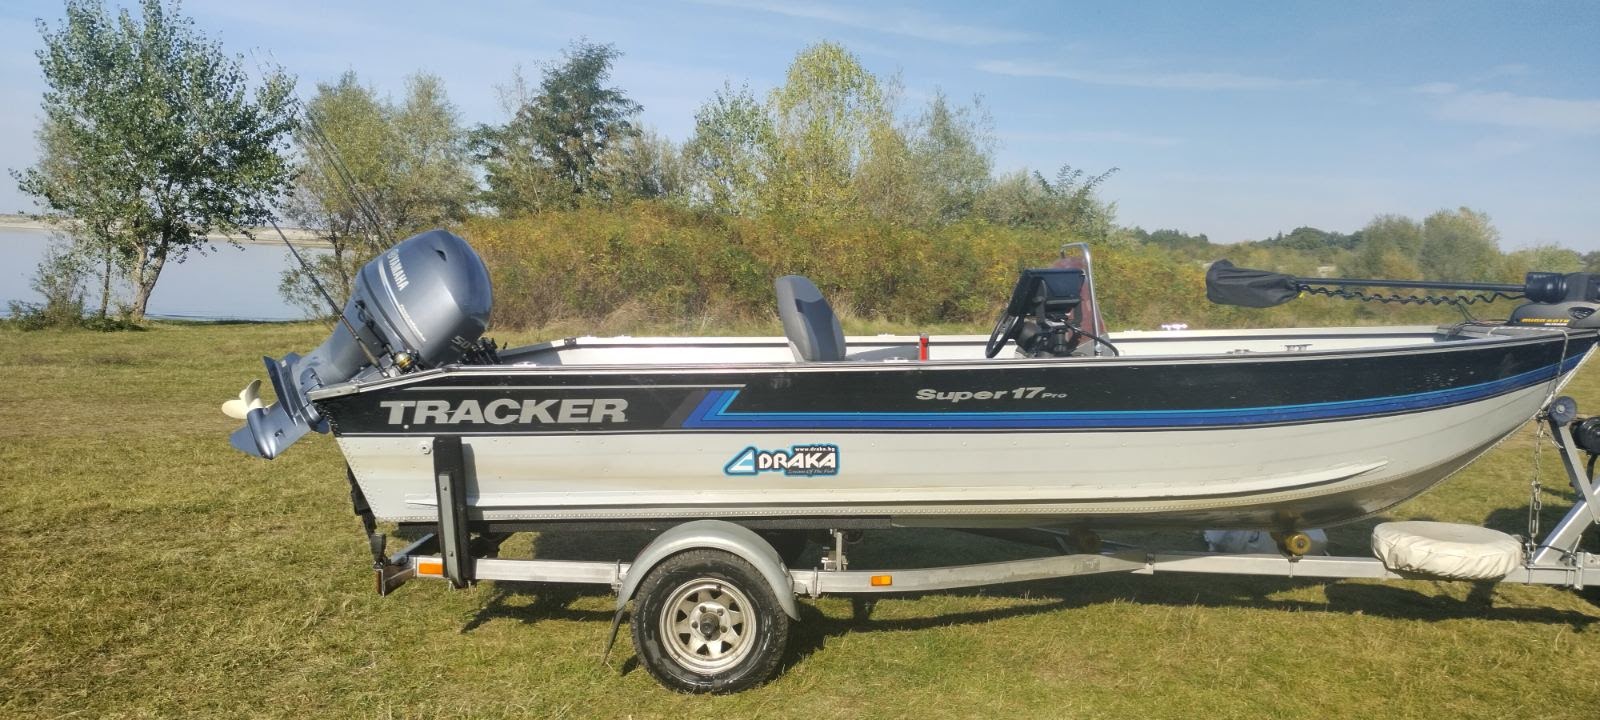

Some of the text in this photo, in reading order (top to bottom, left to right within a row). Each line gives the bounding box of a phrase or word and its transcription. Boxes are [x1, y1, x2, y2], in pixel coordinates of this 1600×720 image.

[388, 253, 409, 291] YAMAHA
[915, 388, 1008, 403] Super
[1011, 386, 1046, 399] 17
[380, 398, 629, 425] TRACKER
[758, 452, 836, 469] DRAKA
